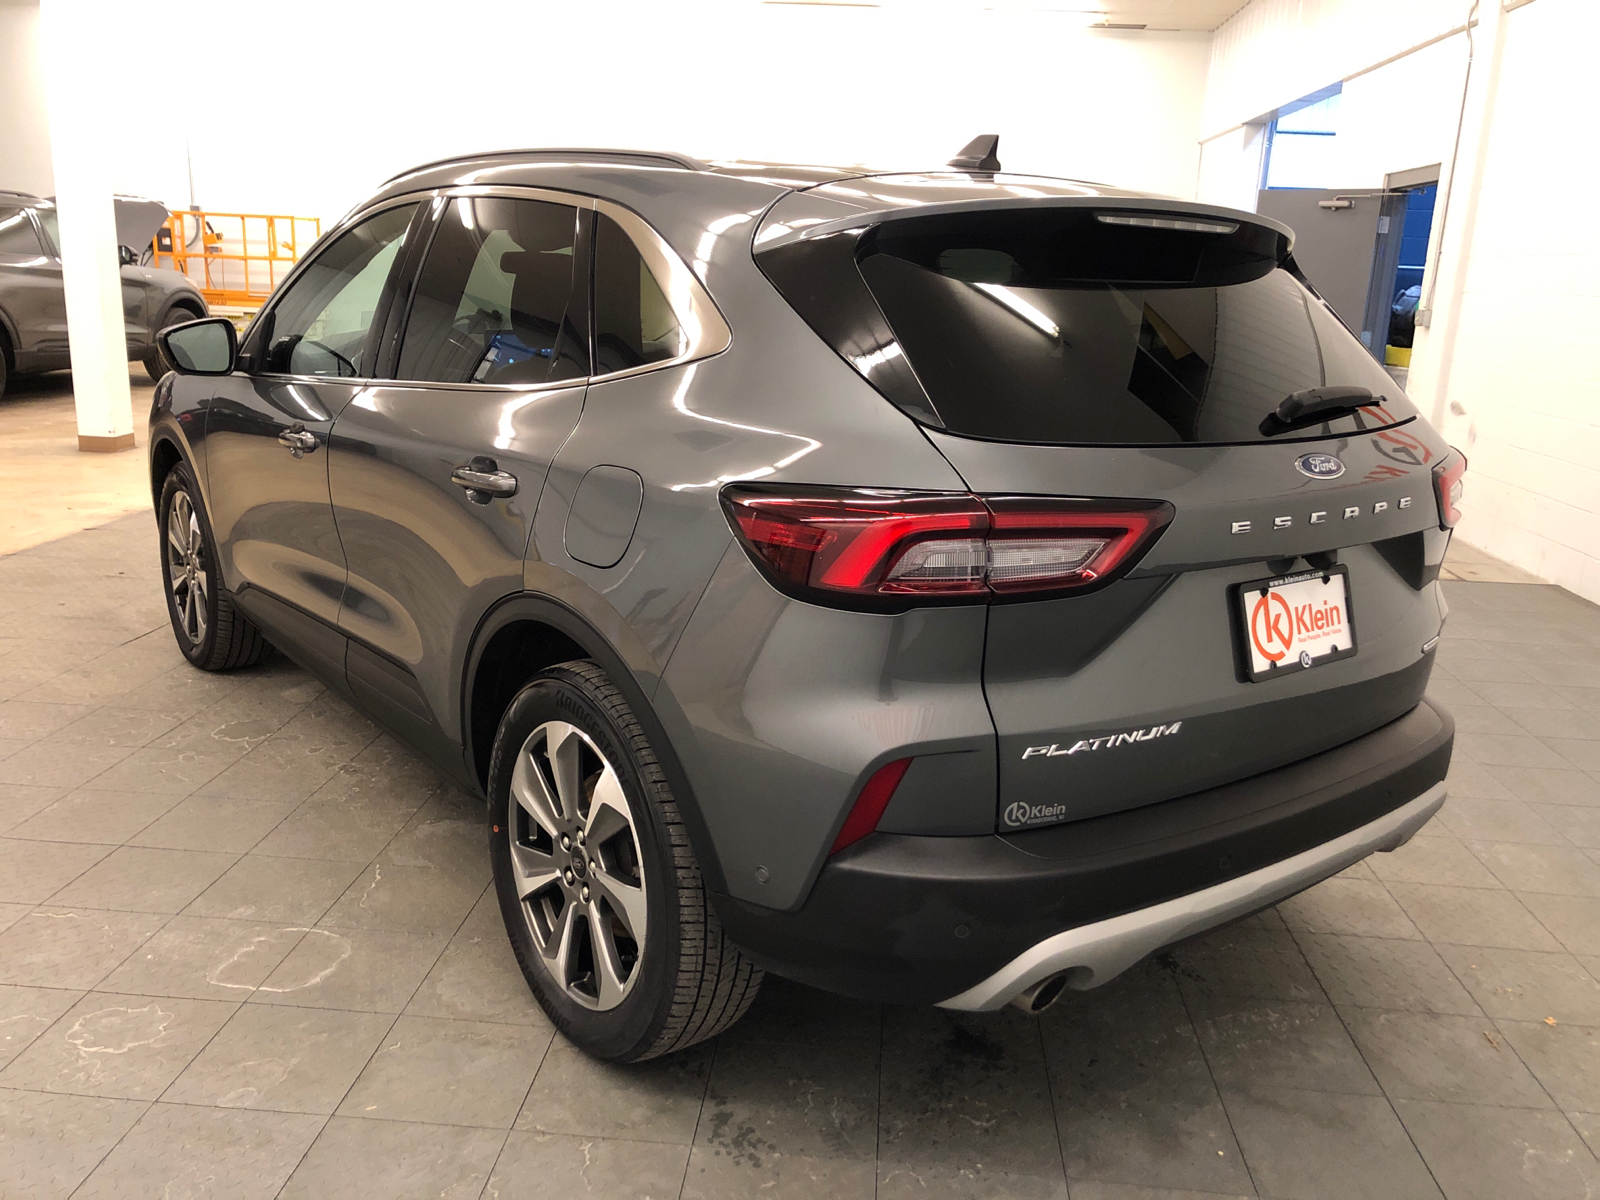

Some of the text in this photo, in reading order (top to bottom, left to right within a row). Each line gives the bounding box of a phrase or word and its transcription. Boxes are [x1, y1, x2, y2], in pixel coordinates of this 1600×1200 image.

[1309, 457, 1337, 472] Ford
[1231, 496, 1413, 535] ESCAPE
[1268, 571, 1324, 587] www.kleinauto.com
[1294, 600, 1341, 635] Klein
[555, 689, 632, 790] BRIDGESTONE
[1021, 721, 1183, 760] PLATINUM
[1031, 803, 1066, 818] Klein
